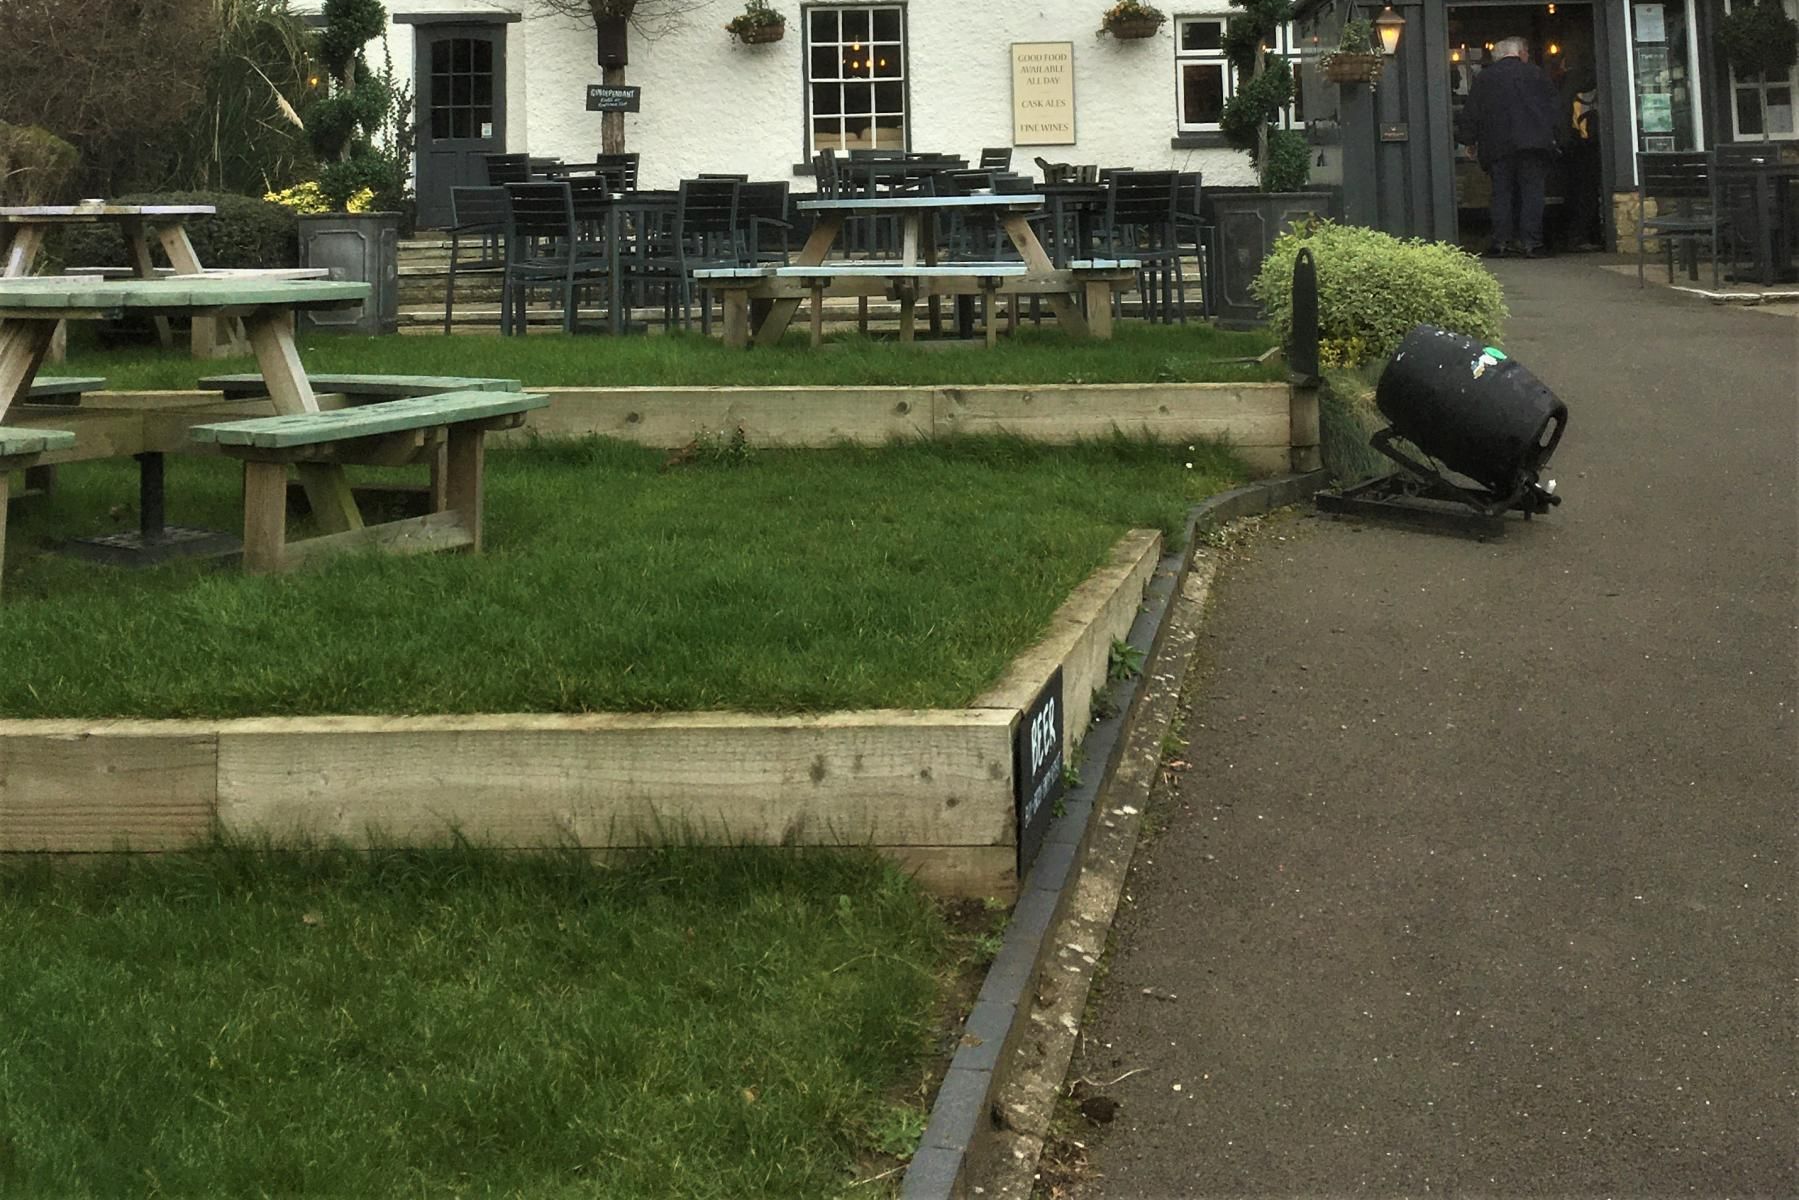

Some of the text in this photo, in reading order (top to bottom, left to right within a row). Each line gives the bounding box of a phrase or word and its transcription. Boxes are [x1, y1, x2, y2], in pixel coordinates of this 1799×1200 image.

[1017, 54, 1067, 63] GOOD FOOD
[1021, 65, 1064, 74] AVAILABLE
[1026, 76, 1060, 85] ALL DAY
[1021, 99, 1066, 109] CASK ALES
[1020, 122, 1070, 132] FINE WINES
[1030, 695, 1057, 778] BEER
